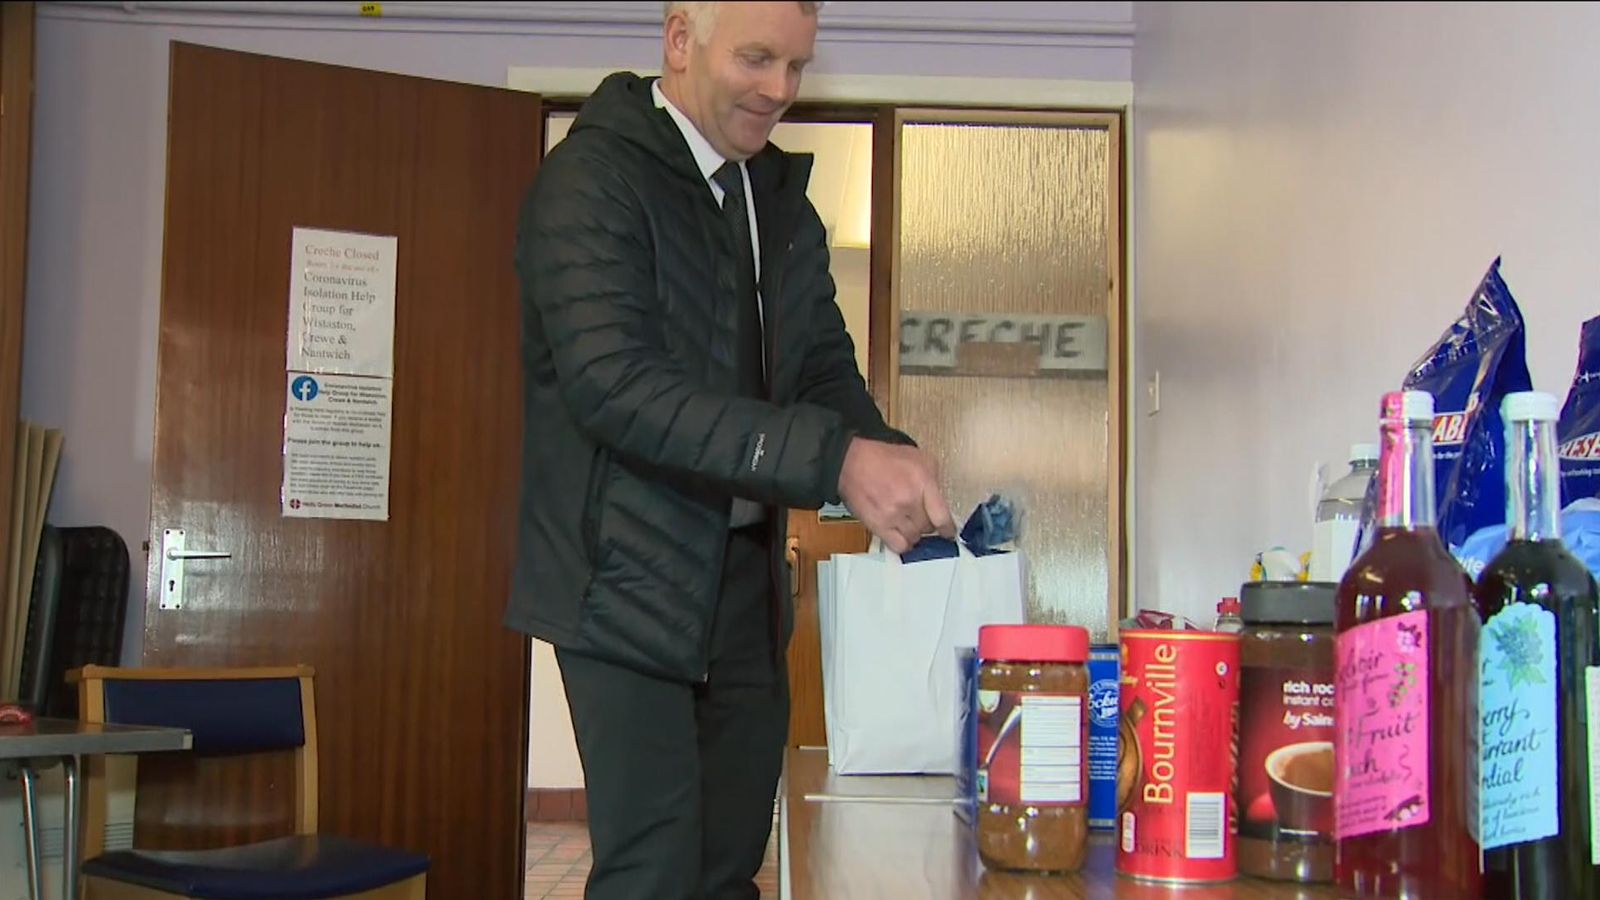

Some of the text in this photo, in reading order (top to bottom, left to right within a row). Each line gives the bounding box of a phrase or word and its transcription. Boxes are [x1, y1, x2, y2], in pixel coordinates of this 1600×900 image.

[305, 244, 380, 261] Creche Closed
[304, 271, 368, 287] Coronavirus
[303, 286, 376, 304] Isolation Help
[302, 302, 353, 316] Group for
[337, 336, 347, 345] &
[301, 347, 350, 360] Nantwich
[1283, 680, 1311, 693] rich
[1283, 695, 1320, 706] instant
[1143, 643, 1178, 804] Bournville
[1283, 710, 1301, 729] by
[1482, 697, 1530, 737] erry
